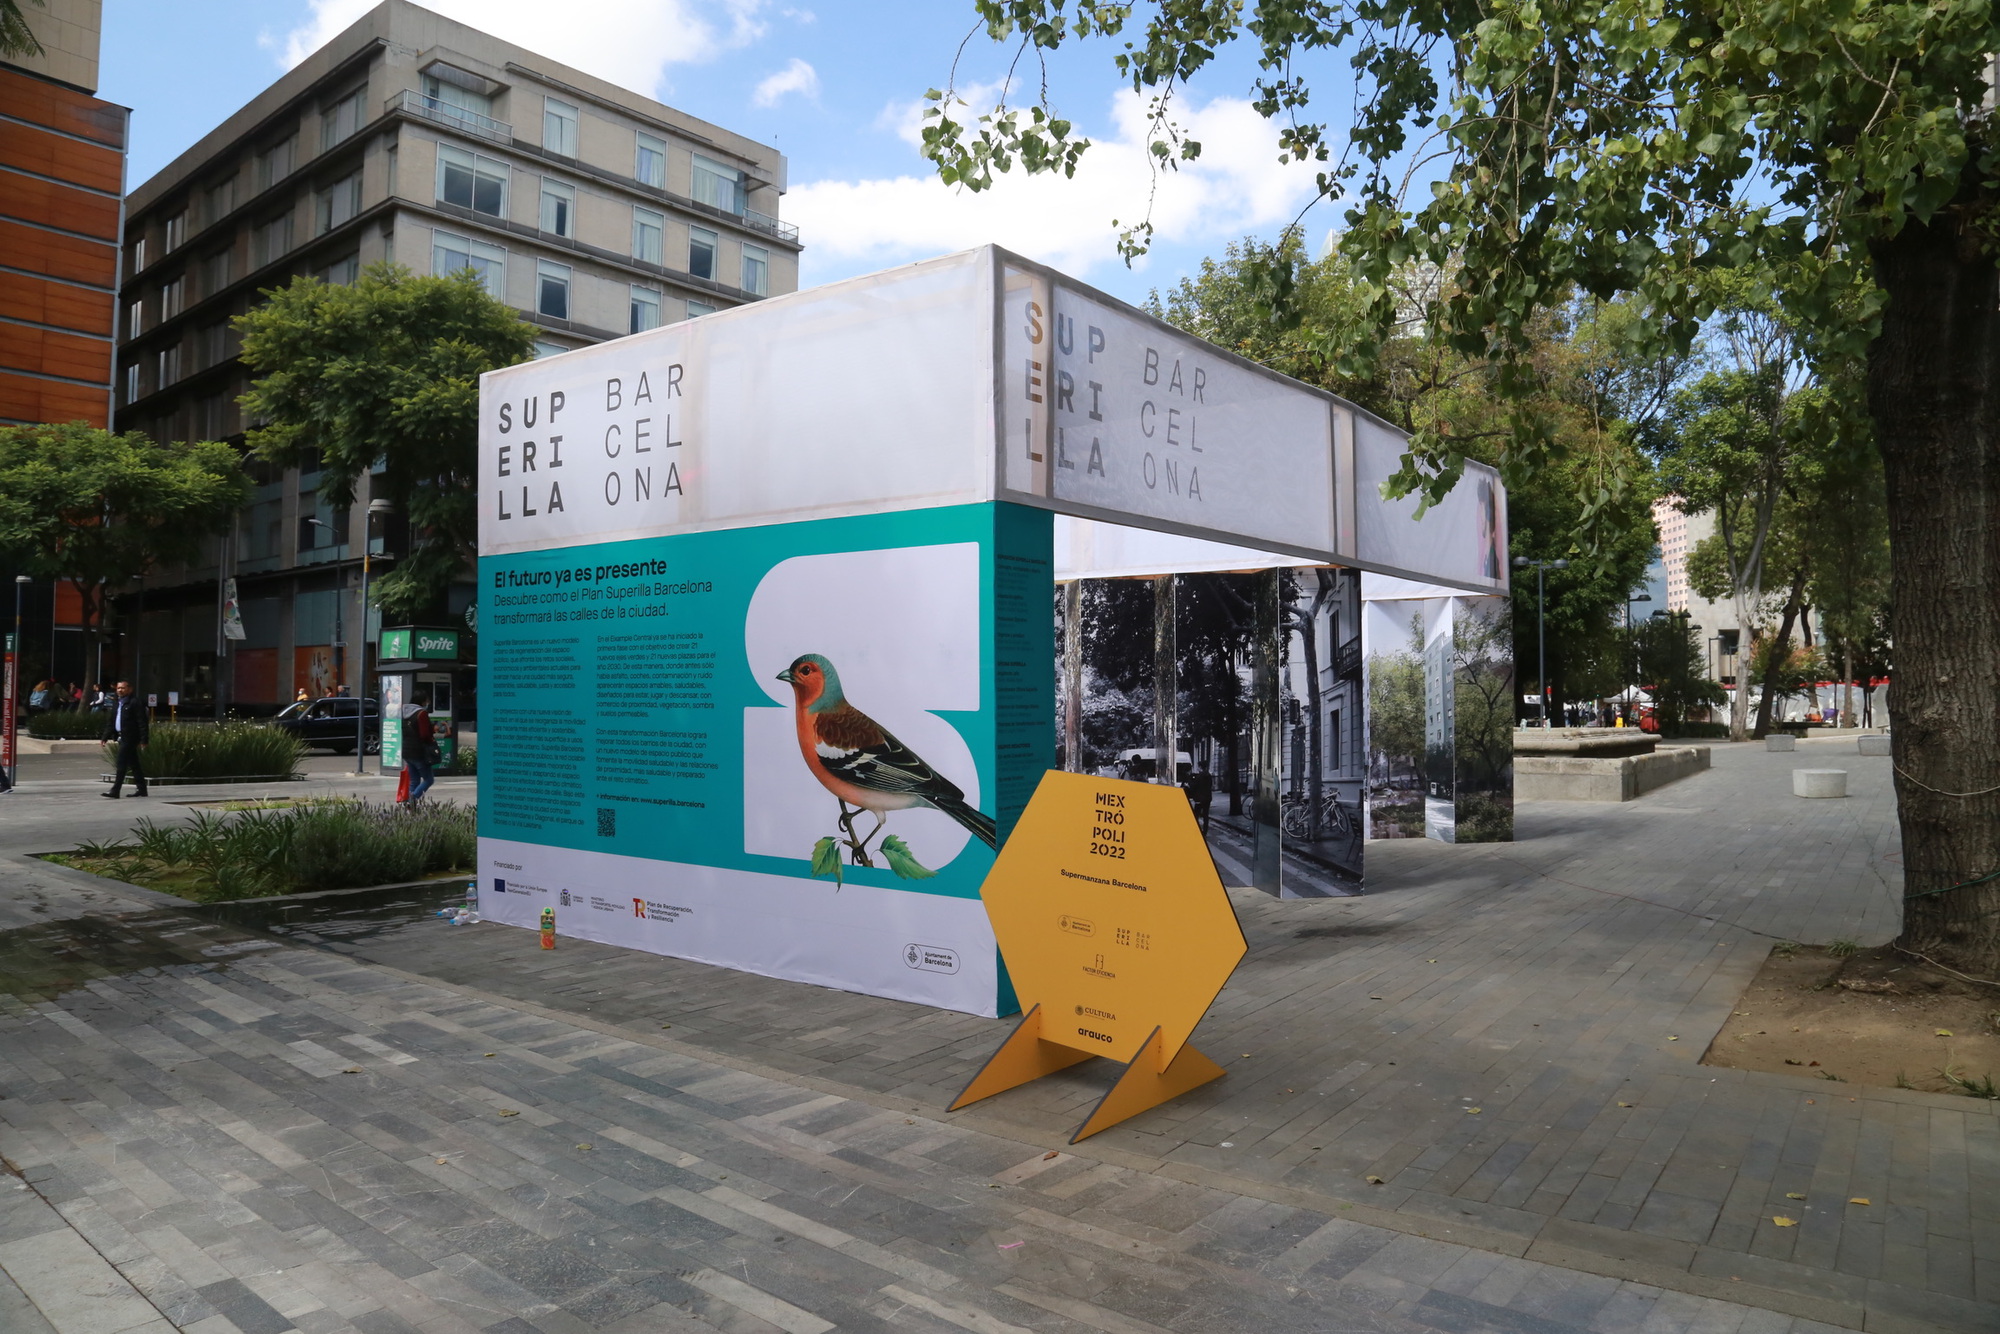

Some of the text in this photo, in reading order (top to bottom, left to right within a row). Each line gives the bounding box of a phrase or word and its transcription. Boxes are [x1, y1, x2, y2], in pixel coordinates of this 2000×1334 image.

[1024, 301, 1105, 364] SUP
[607, 362, 684, 412] BAR
[1025, 358, 1103, 422] ERI
[1143, 347, 1206, 404] BAR
[499, 390, 565, 435] SUP
[1141, 400, 1203, 453] CEL
[605, 413, 682, 458] CEL
[1025, 417, 1105, 477] LLA
[498, 435, 564, 478] ERI
[604, 462, 683, 506] ONA
[1143, 451, 1202, 501] ONA
[498, 481, 564, 521] LLA
[494, 558, 667, 588] El futuro ya es presente
[494, 578, 712, 607] Descubre como el Plan Superilla Barcelona
[494, 602, 669, 626] transformará las calles de la ciudad.
[418, 636, 454, 652] Sprite
[1096, 792, 1126, 808] MEX
[1092, 826, 1125, 844] POLI
[1095, 810, 1124, 826] TRÓ
[1090, 842, 1126, 860] 2022
[1060, 868, 1147, 892] Supermanzana Barcelona
[925, 957, 952, 967] Barcelona
[1085, 1007, 1116, 1020] CULTURA
[1078, 1028, 1112, 1043] arauco
